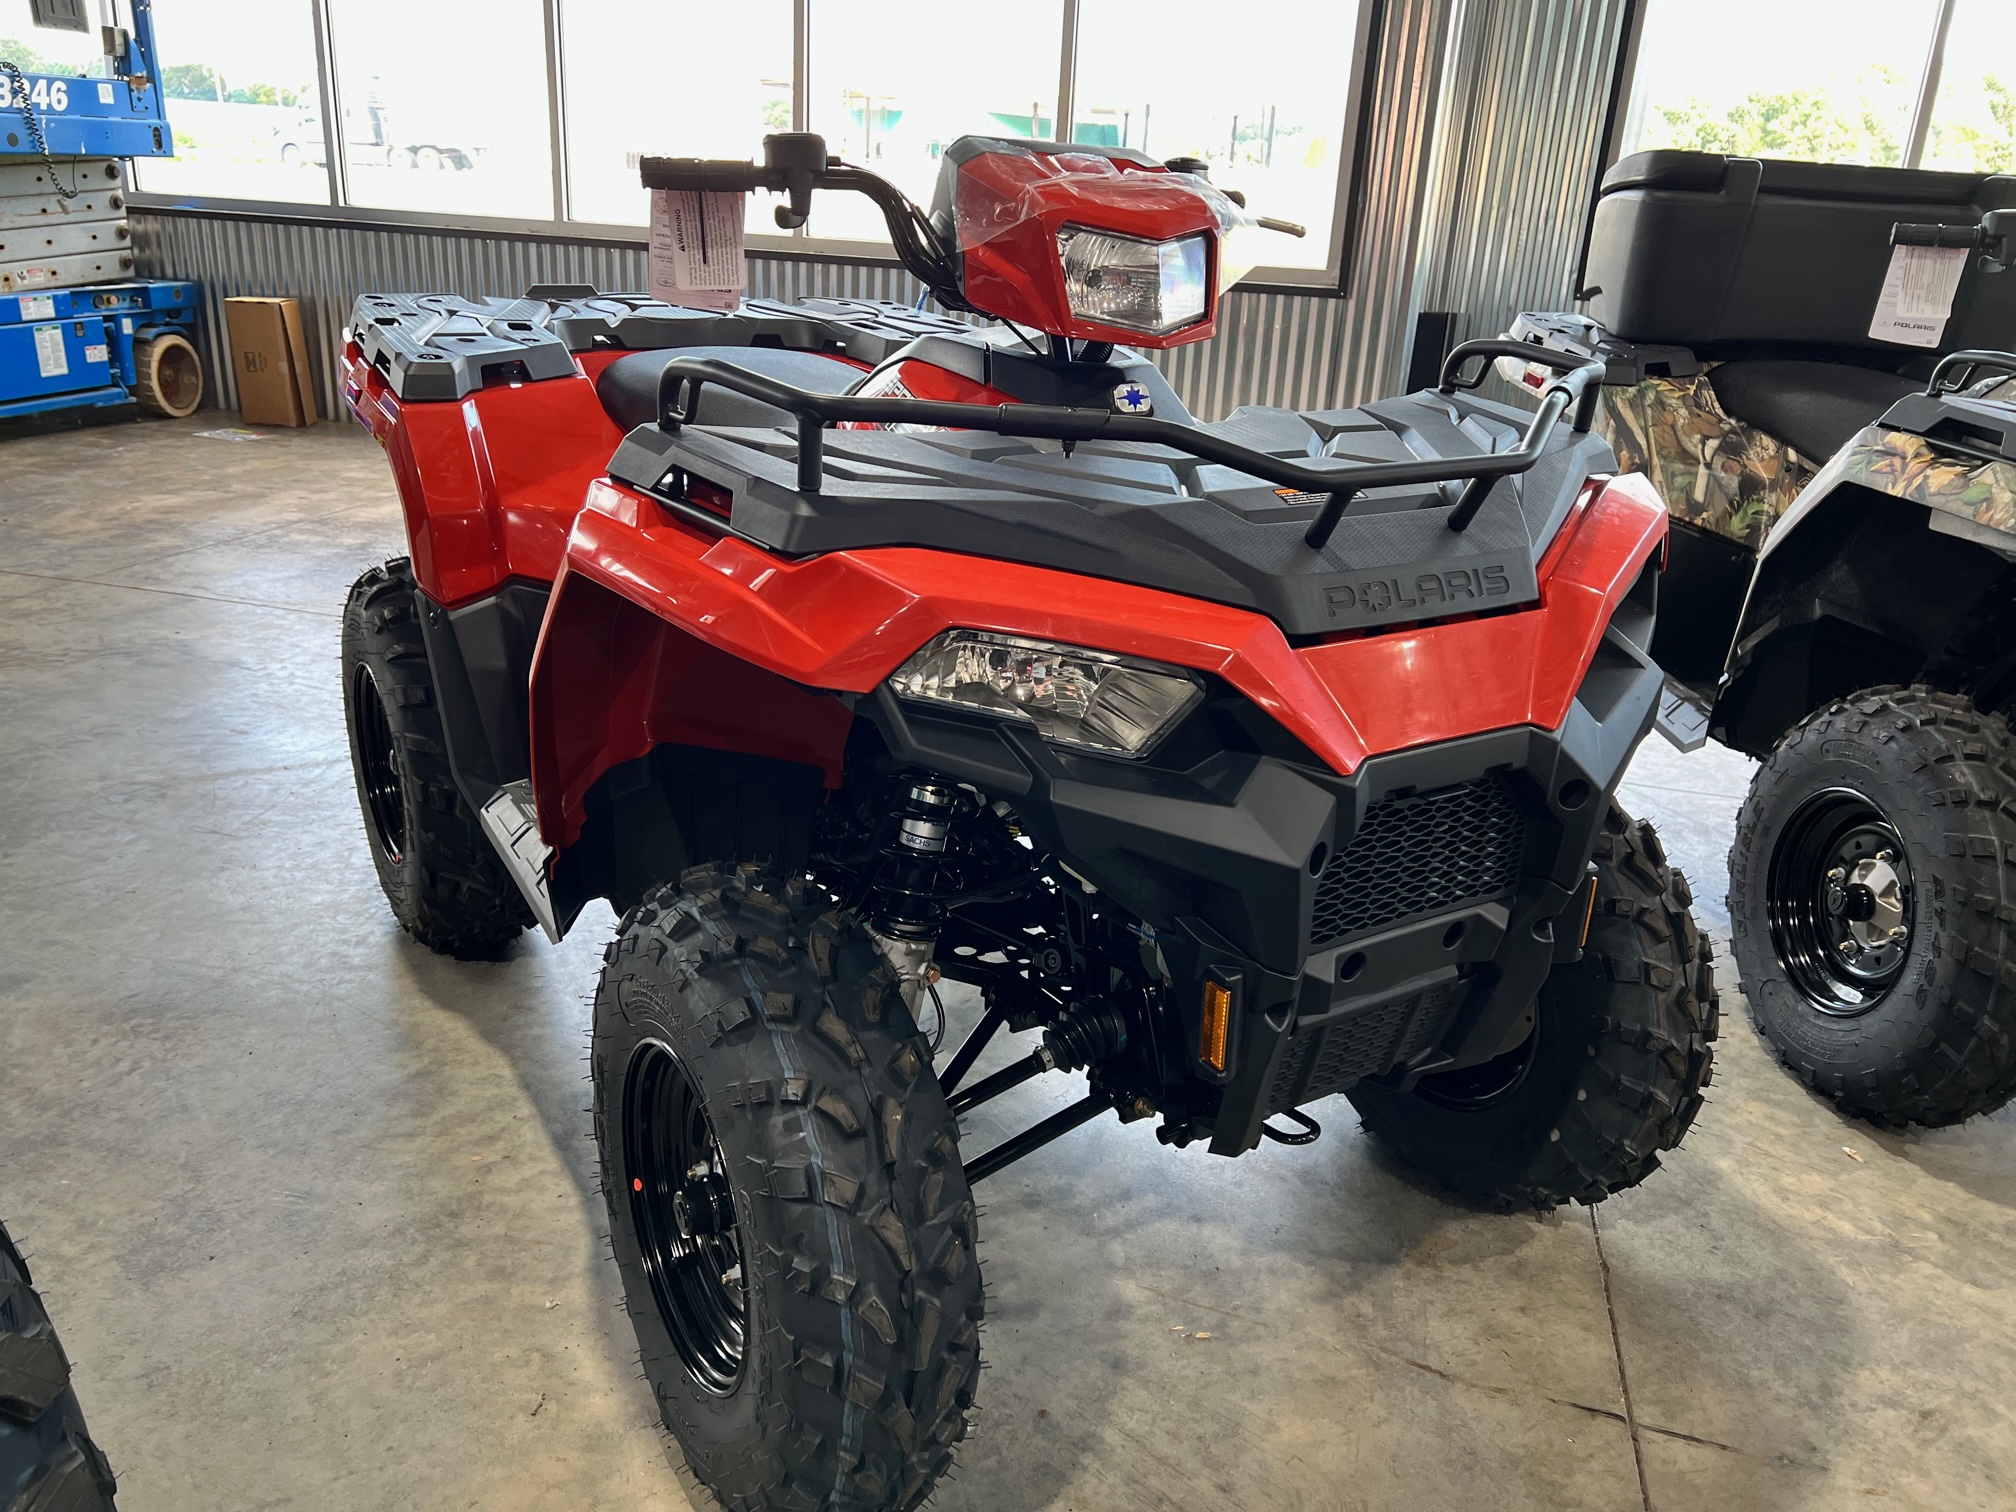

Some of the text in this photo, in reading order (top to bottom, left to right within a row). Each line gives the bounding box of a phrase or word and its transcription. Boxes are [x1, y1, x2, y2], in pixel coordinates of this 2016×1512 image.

[675, 209, 684, 244] WARNING
[1893, 321, 1936, 331] POLARIS
[1322, 565, 1510, 618] POLARIS
[905, 835, 930, 847] SACHS
